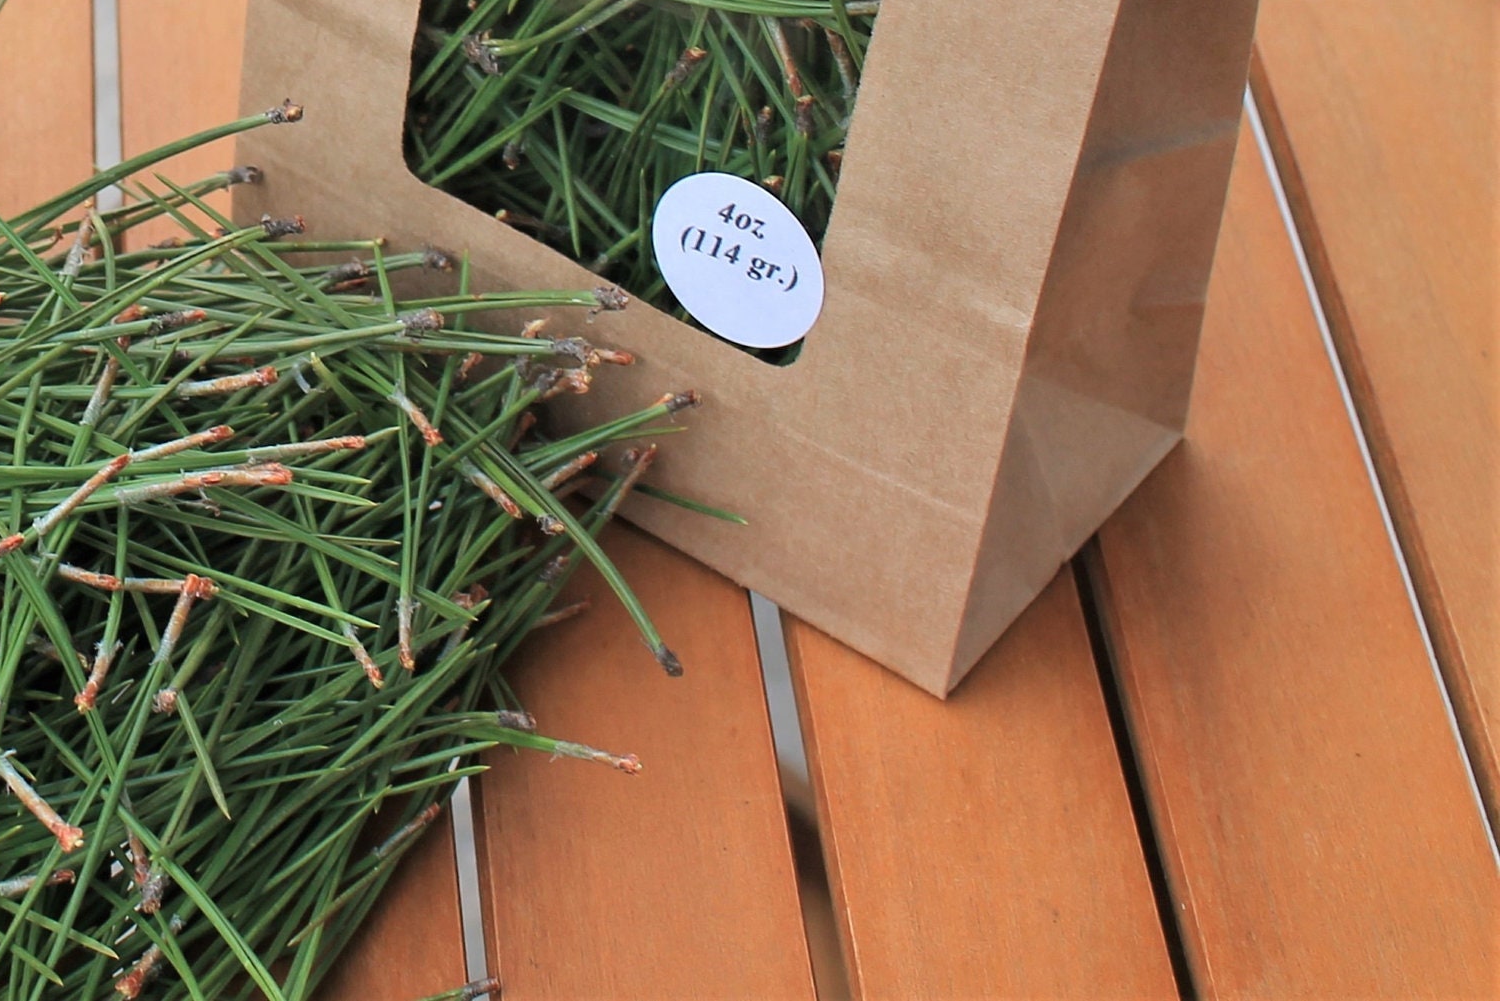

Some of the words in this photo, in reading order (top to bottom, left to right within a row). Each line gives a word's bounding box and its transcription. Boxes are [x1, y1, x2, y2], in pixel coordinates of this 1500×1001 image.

[717, 202, 767, 241] 4oz
[680, 225, 742, 265] (114
[746, 256, 799, 293] gr.)
